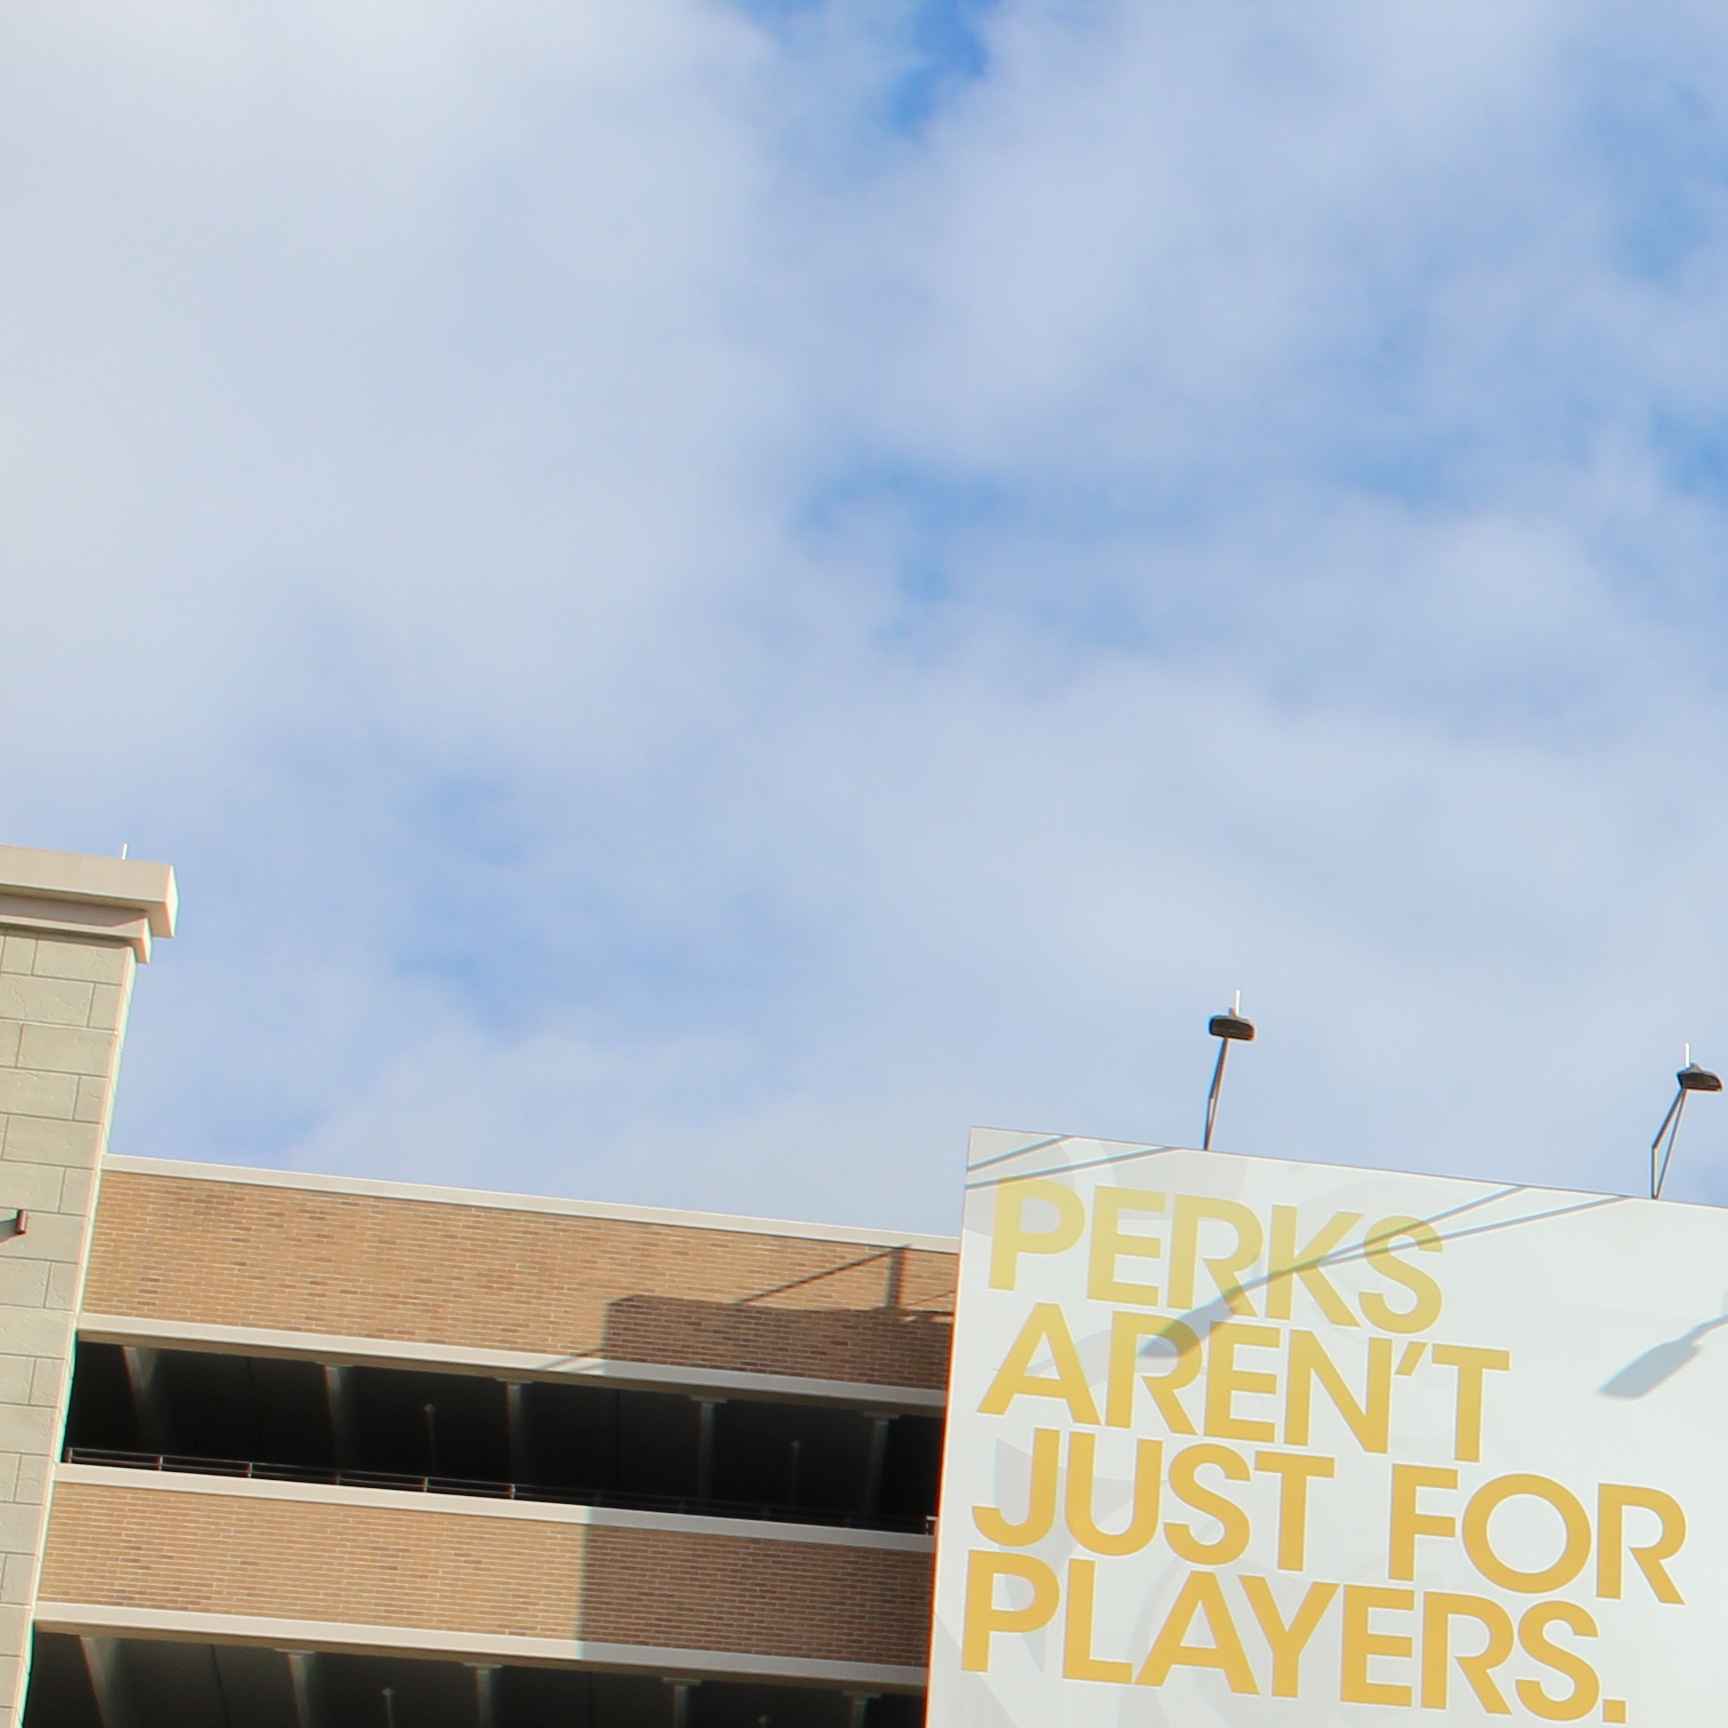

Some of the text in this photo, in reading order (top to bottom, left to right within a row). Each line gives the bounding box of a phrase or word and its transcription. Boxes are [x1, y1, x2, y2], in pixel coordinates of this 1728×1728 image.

[987, 1176, 1444, 1334] PERKS
[976, 1300, 1511, 1464] AREN'T
[971, 1428, 1687, 1606] JUST FOR
[961, 1550, 1628, 1724] PLAYERS.
